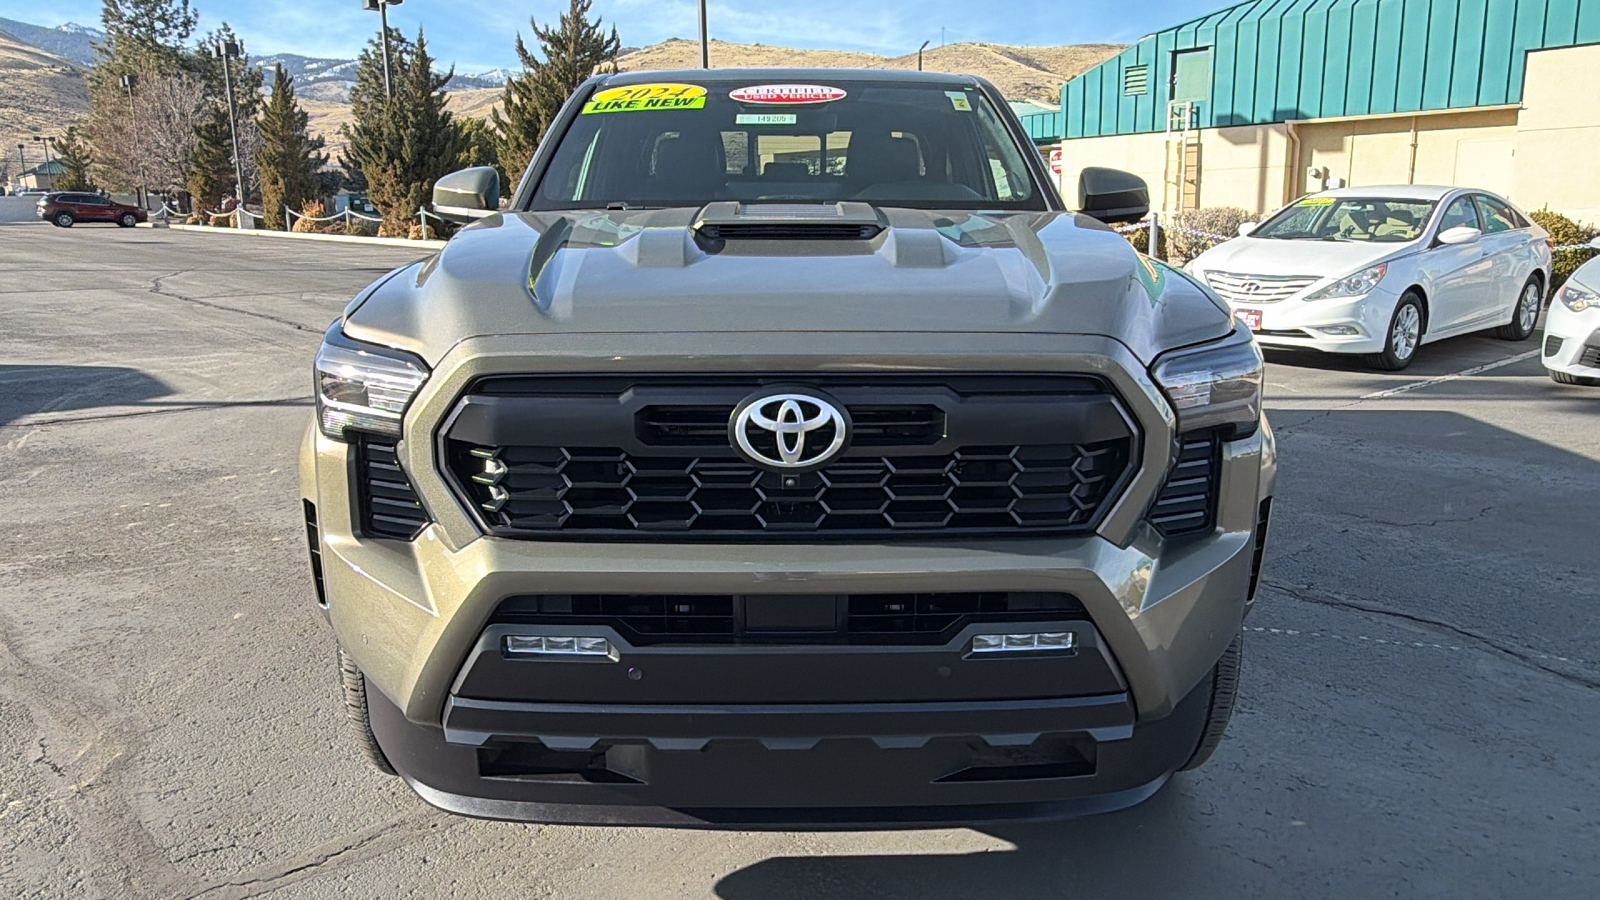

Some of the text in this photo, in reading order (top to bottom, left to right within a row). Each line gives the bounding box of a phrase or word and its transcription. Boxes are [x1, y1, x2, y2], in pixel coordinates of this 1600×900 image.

[615, 87, 692, 100] 2024
[592, 97, 696, 110] LIKE NEW
